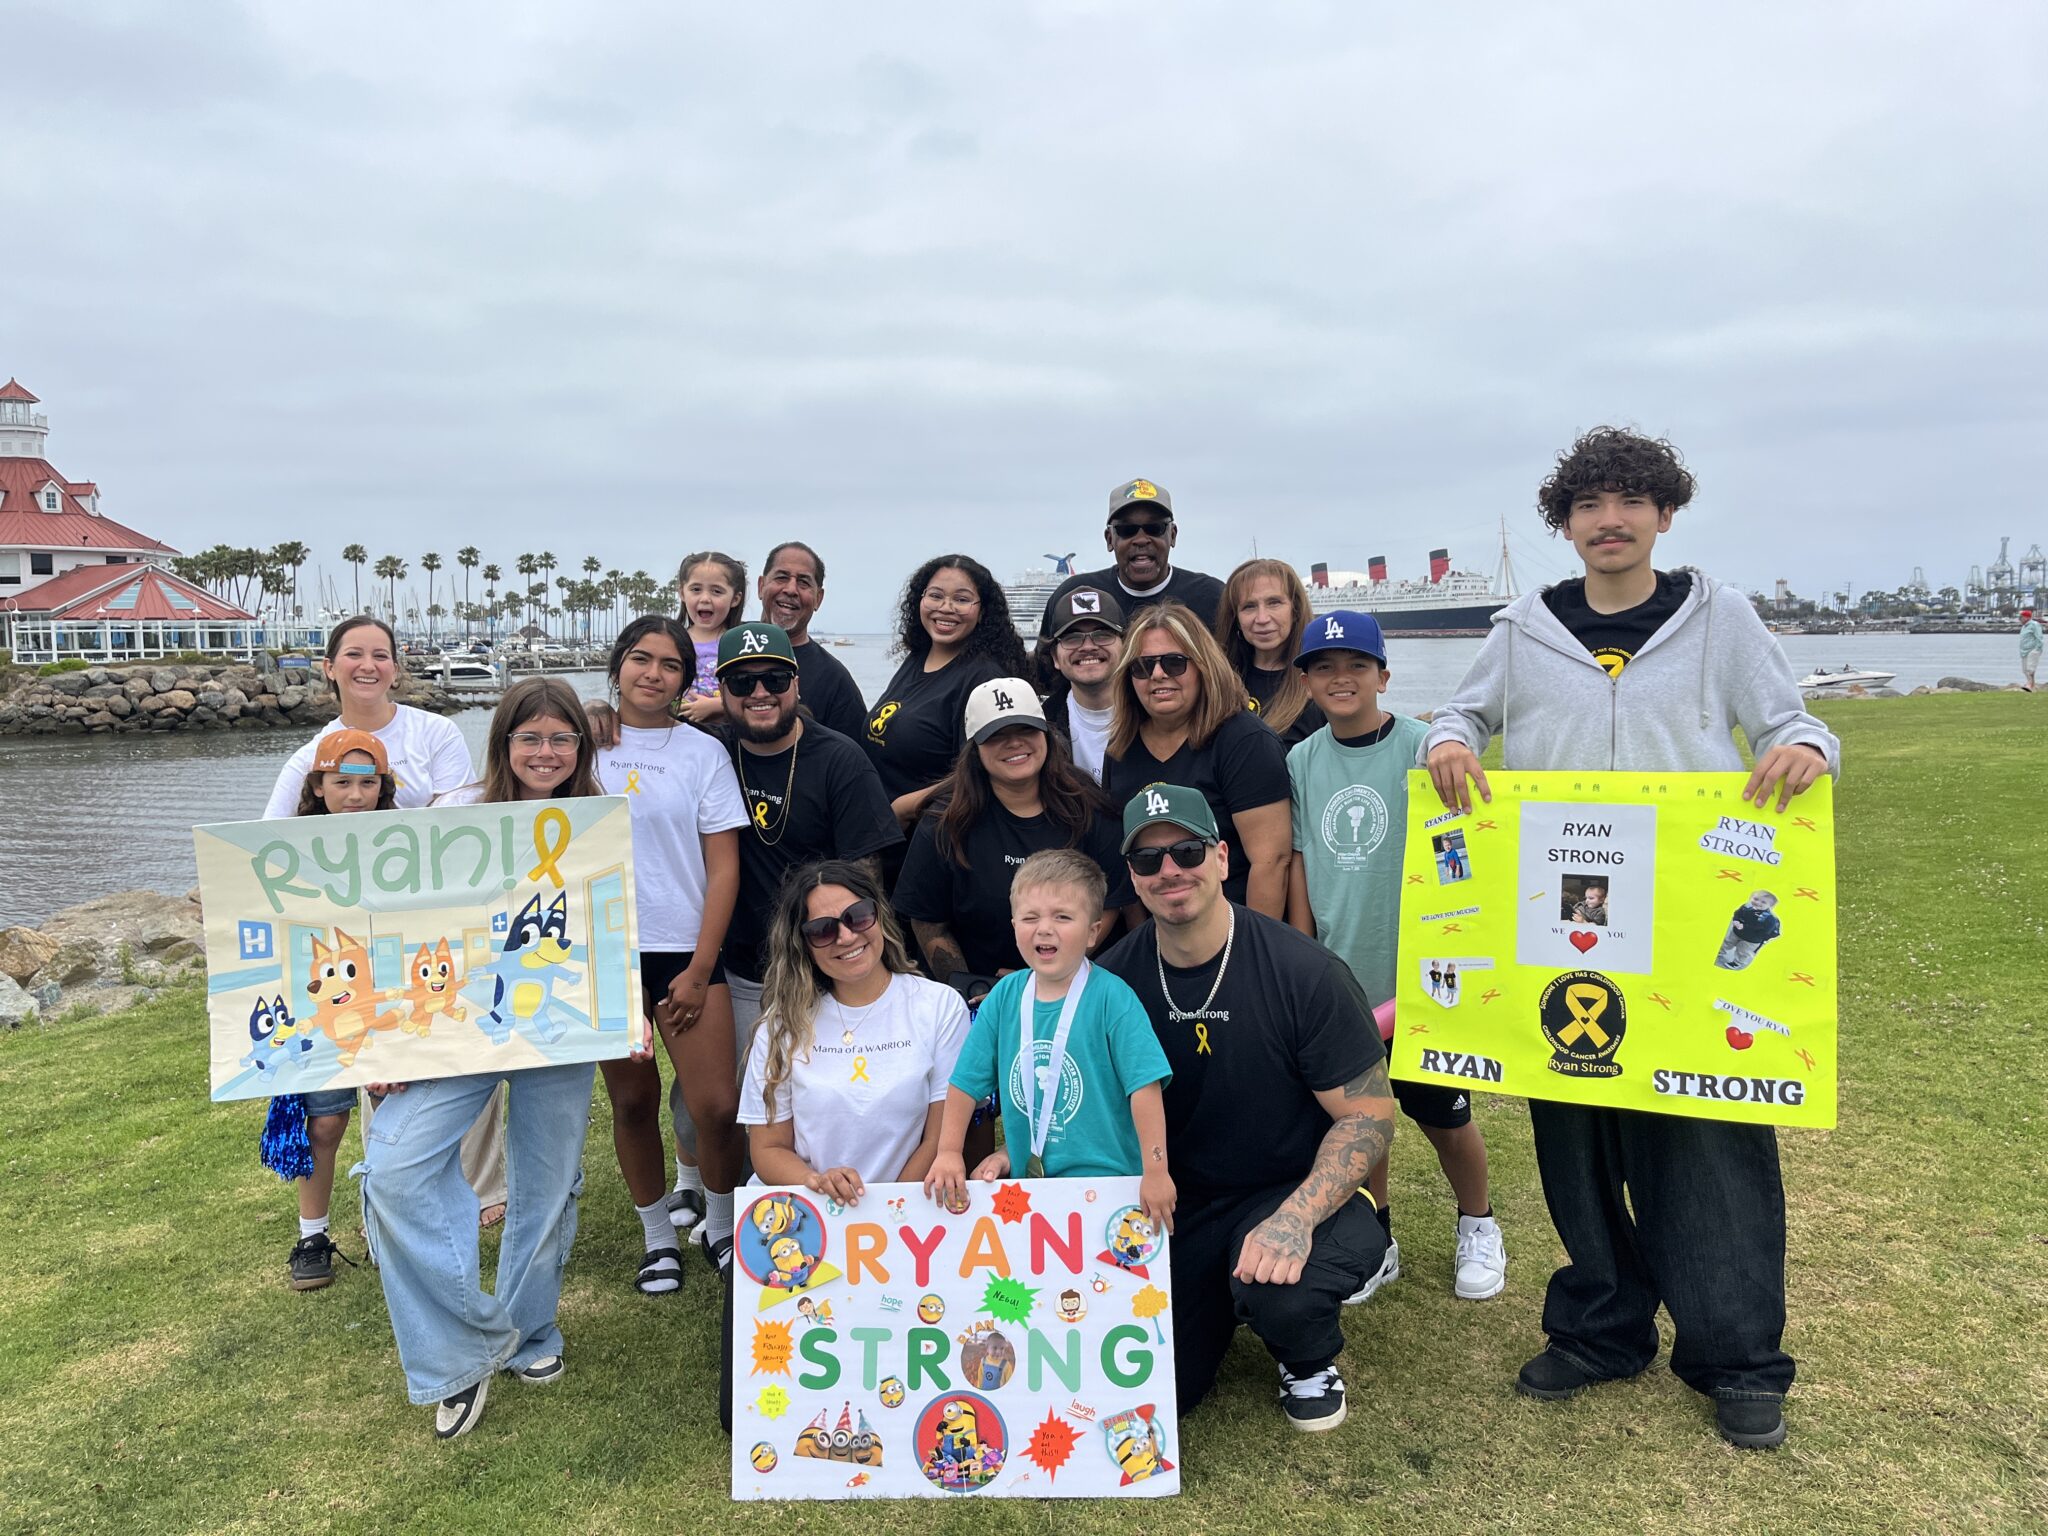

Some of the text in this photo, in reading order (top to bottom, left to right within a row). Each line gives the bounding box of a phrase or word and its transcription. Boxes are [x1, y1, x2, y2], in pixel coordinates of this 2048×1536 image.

[1325, 617, 1344, 640] LA
[739, 629, 769, 655] A's
[992, 689, 1014, 711] LA
[610, 760, 665, 774] Ryan Strong
[1145, 789, 1169, 816] LA
[1424, 812, 1444, 828] RYAN
[1562, 823, 1612, 837] RYAN
[1718, 816, 1776, 840] RYAN
[1548, 848, 1624, 865] STRONG
[1701, 834, 1780, 865] STRONG
[251, 815, 518, 914] Ryan!
[1004, 855, 1026, 865] Ryan
[1430, 912, 1443, 920] LOVE
[1551, 927, 1626, 939] WE YOU
[1557, 974, 1573, 984] LOVE
[1589, 972, 1621, 996] CHILDHOOD
[1744, 1011, 1764, 1024] YOU
[812, 1044, 843, 1054] Mama
[845, 1045, 857, 1054] of
[864, 1039, 912, 1053] WARRIOR
[1542, 1025, 1569, 1055] CHILDHOOD
[1570, 1052, 1597, 1060] CANCER
[1420, 1048, 1502, 1083] RYAN
[1548, 1058, 1619, 1075] Ryan Strong
[1653, 1069, 1803, 1105] STRONG
[844, 1211, 1084, 1288] RYAN
[881, 1293, 903, 1307] hope
[1070, 1398, 1097, 1417] laugh
